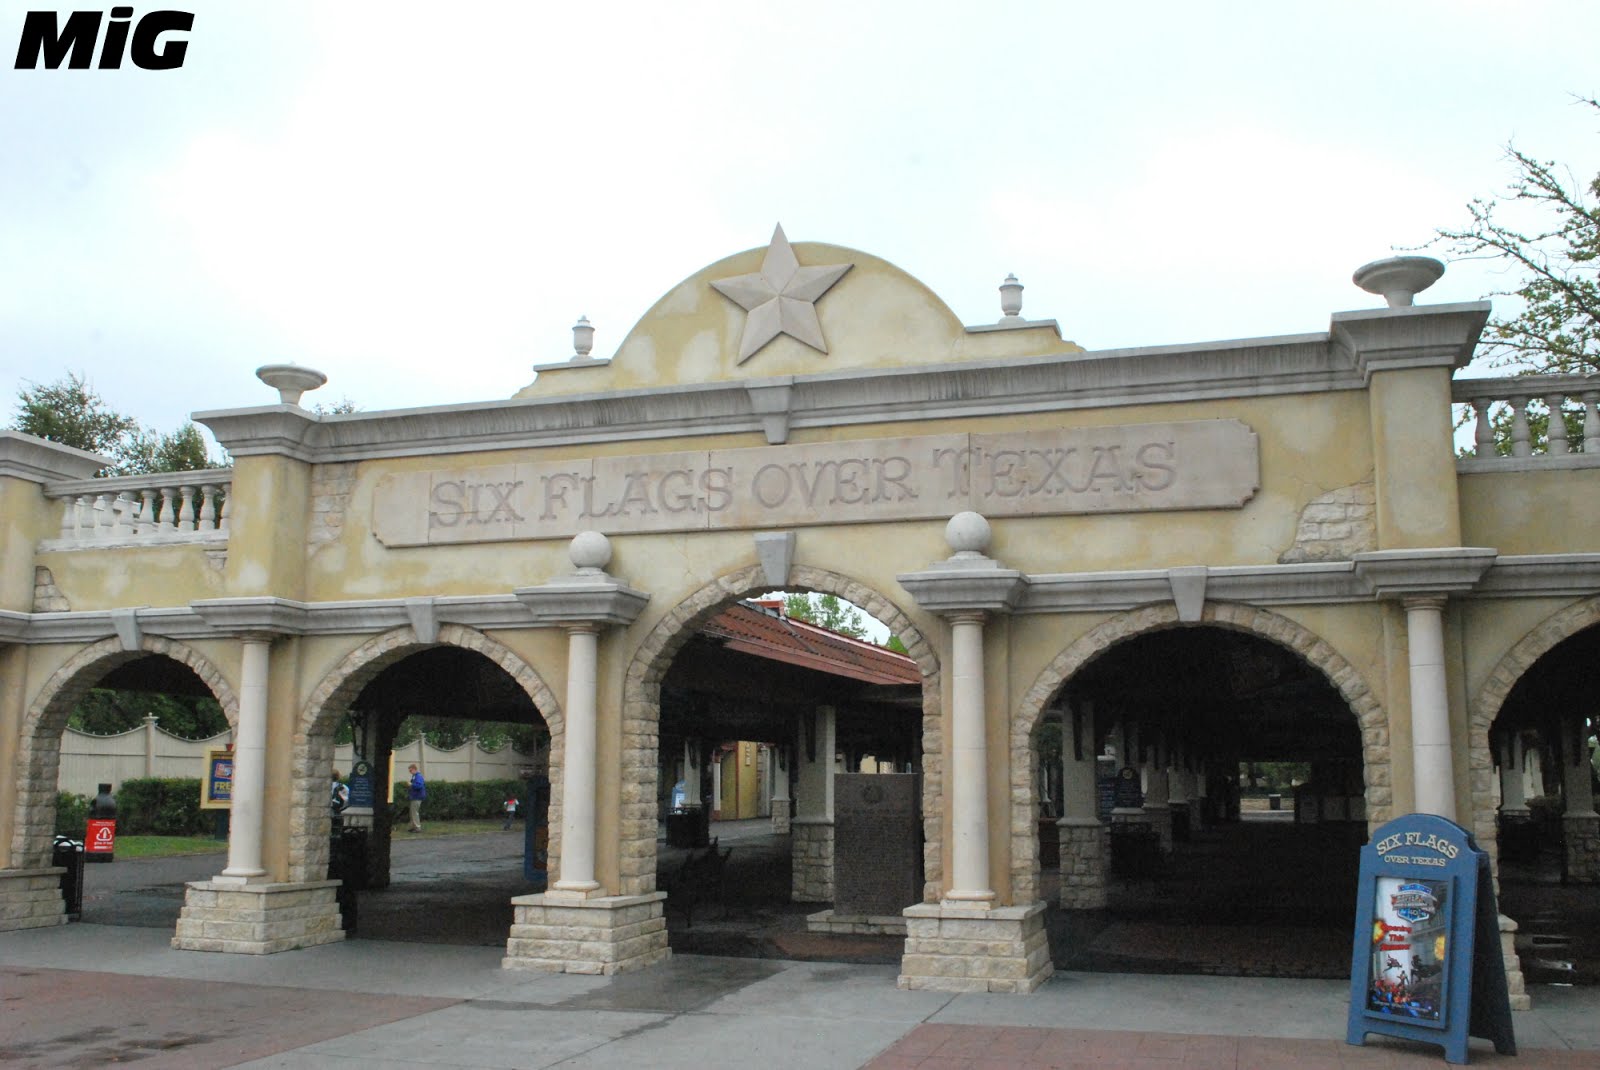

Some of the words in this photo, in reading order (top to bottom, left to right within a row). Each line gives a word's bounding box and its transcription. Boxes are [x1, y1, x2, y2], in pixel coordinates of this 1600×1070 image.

[428, 479, 526, 529] SIX
[538, 466, 735, 521] FLAGS
[751, 455, 920, 510] OVER
[932, 440, 1180, 501] TEXAS
[1376, 832, 1402, 856] SIX
[1404, 831, 1459, 859] FLAGS
[1384, 855, 1410, 864] OVER
[1411, 856, 1446, 867] TEXAS
